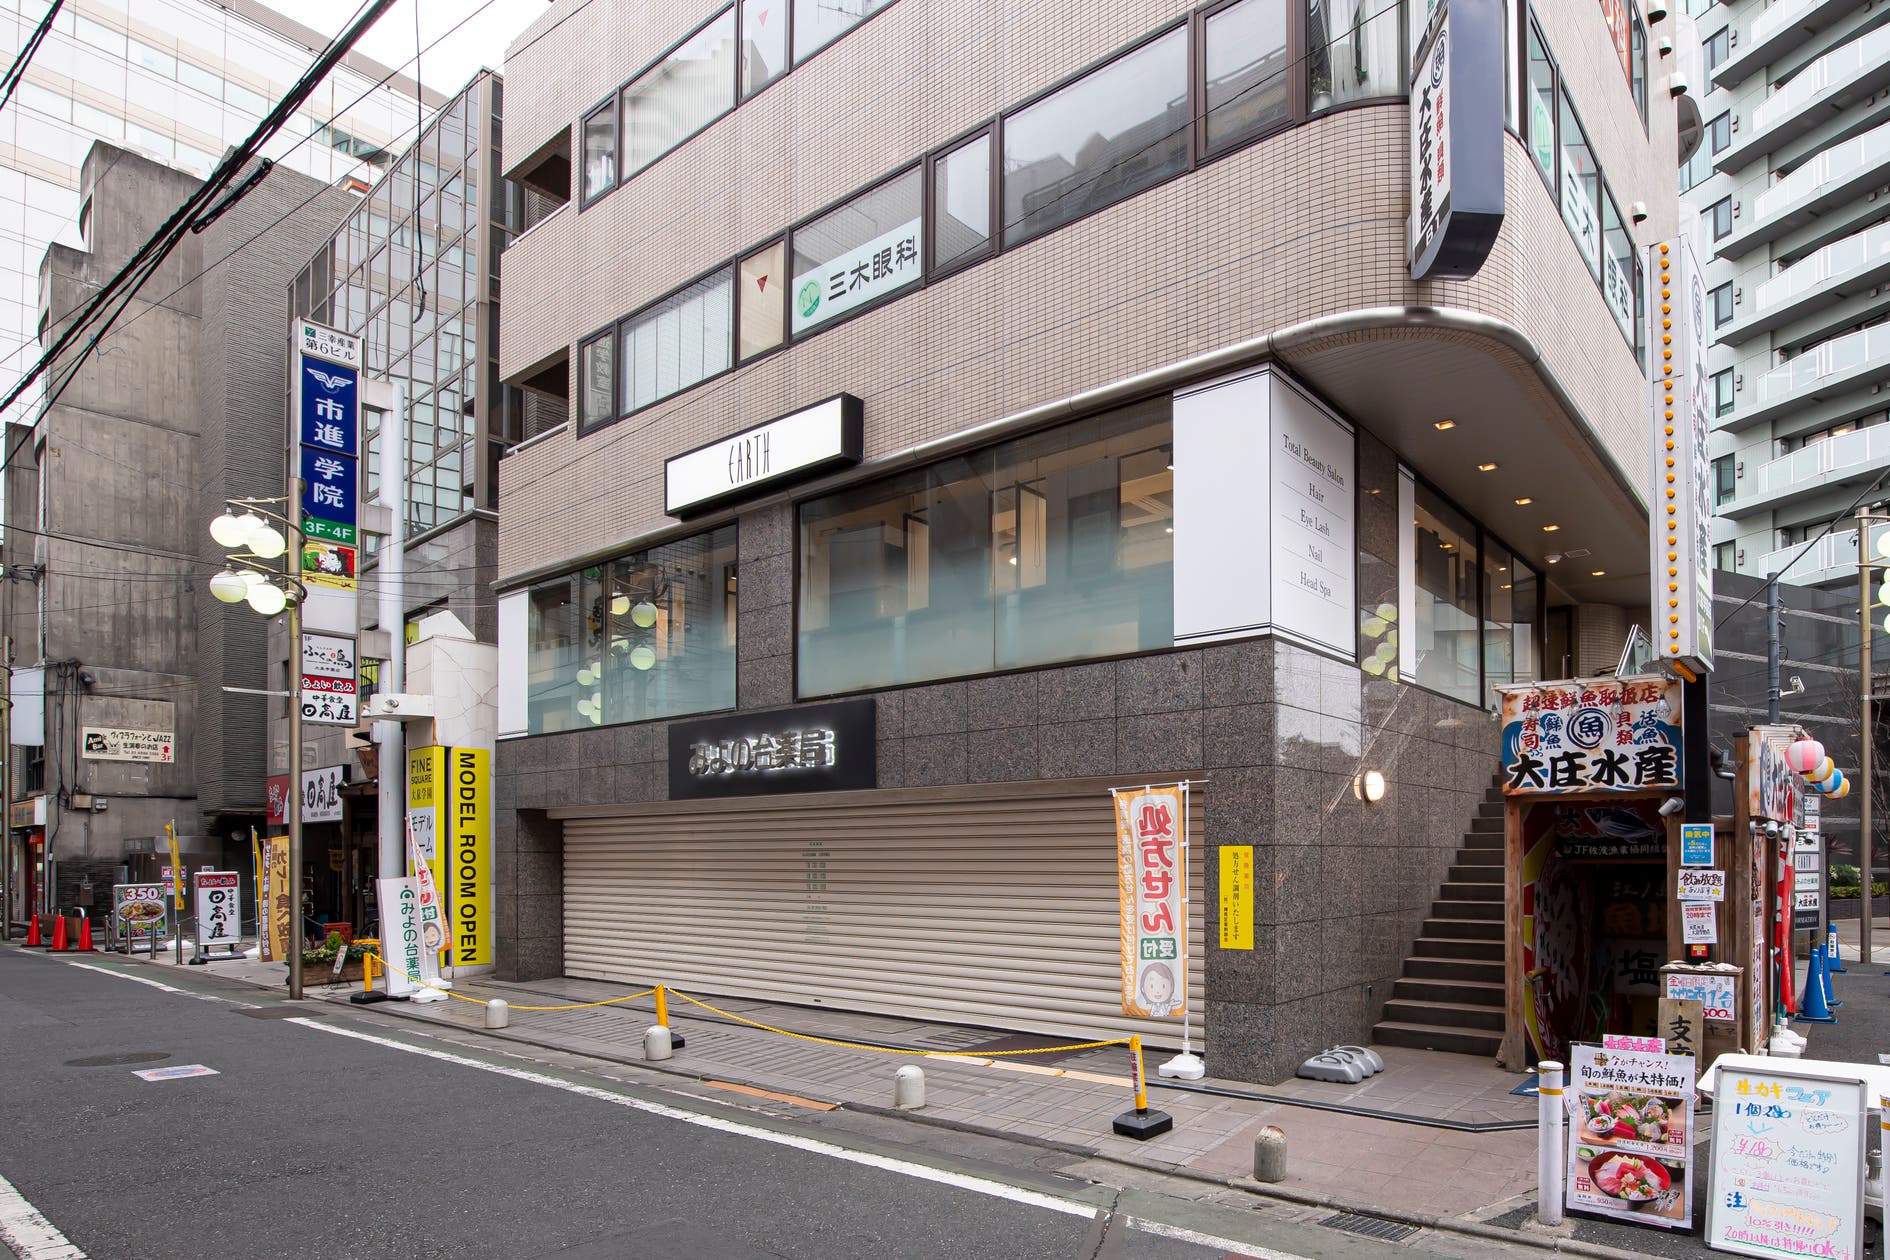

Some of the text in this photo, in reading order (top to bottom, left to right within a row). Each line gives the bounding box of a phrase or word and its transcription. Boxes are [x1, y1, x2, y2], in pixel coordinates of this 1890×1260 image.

[1419, 84, 1432, 234] 大庄水産
[828, 236, 918, 302] 三木眼科
[306, 337, 355, 361] 第6ビル
[728, 432, 770, 485] EARTH
[1283, 433, 1344, 487] Total Beauty Salon
[1308, 482, 1324, 503] Hair
[1300, 508, 1330, 537] Eye Lash
[1308, 544, 1323, 563] Nail
[1300, 571, 1331, 599] Head Spa
[302, 678, 354, 692] ちょい飲み
[1522, 685, 1660, 713] 超速鮮魚取扱店
[302, 703, 355, 720] 日高屋
[1523, 717, 1541, 750] 寿司
[1545, 715, 1563, 750] 鮮魚
[1579, 716, 1604, 739] 魚
[1616, 712, 1634, 746] 貝類
[1640, 710, 1659, 744] 活魚
[411, 757, 432, 773] FINE
[1508, 746, 1677, 789] 大庄水産
[307, 771, 338, 811] 日高屋
[411, 774, 432, 786] SQUARE
[411, 786, 432, 801] 大泉学園
[459, 752, 477, 962] MODEL ROOM OPEN
[126, 887, 159, 901] 350
[208, 890, 228, 940] 日高屋
[400, 902, 423, 985] みよの台薬局
[1726, 1191, 1748, 1208] 注
